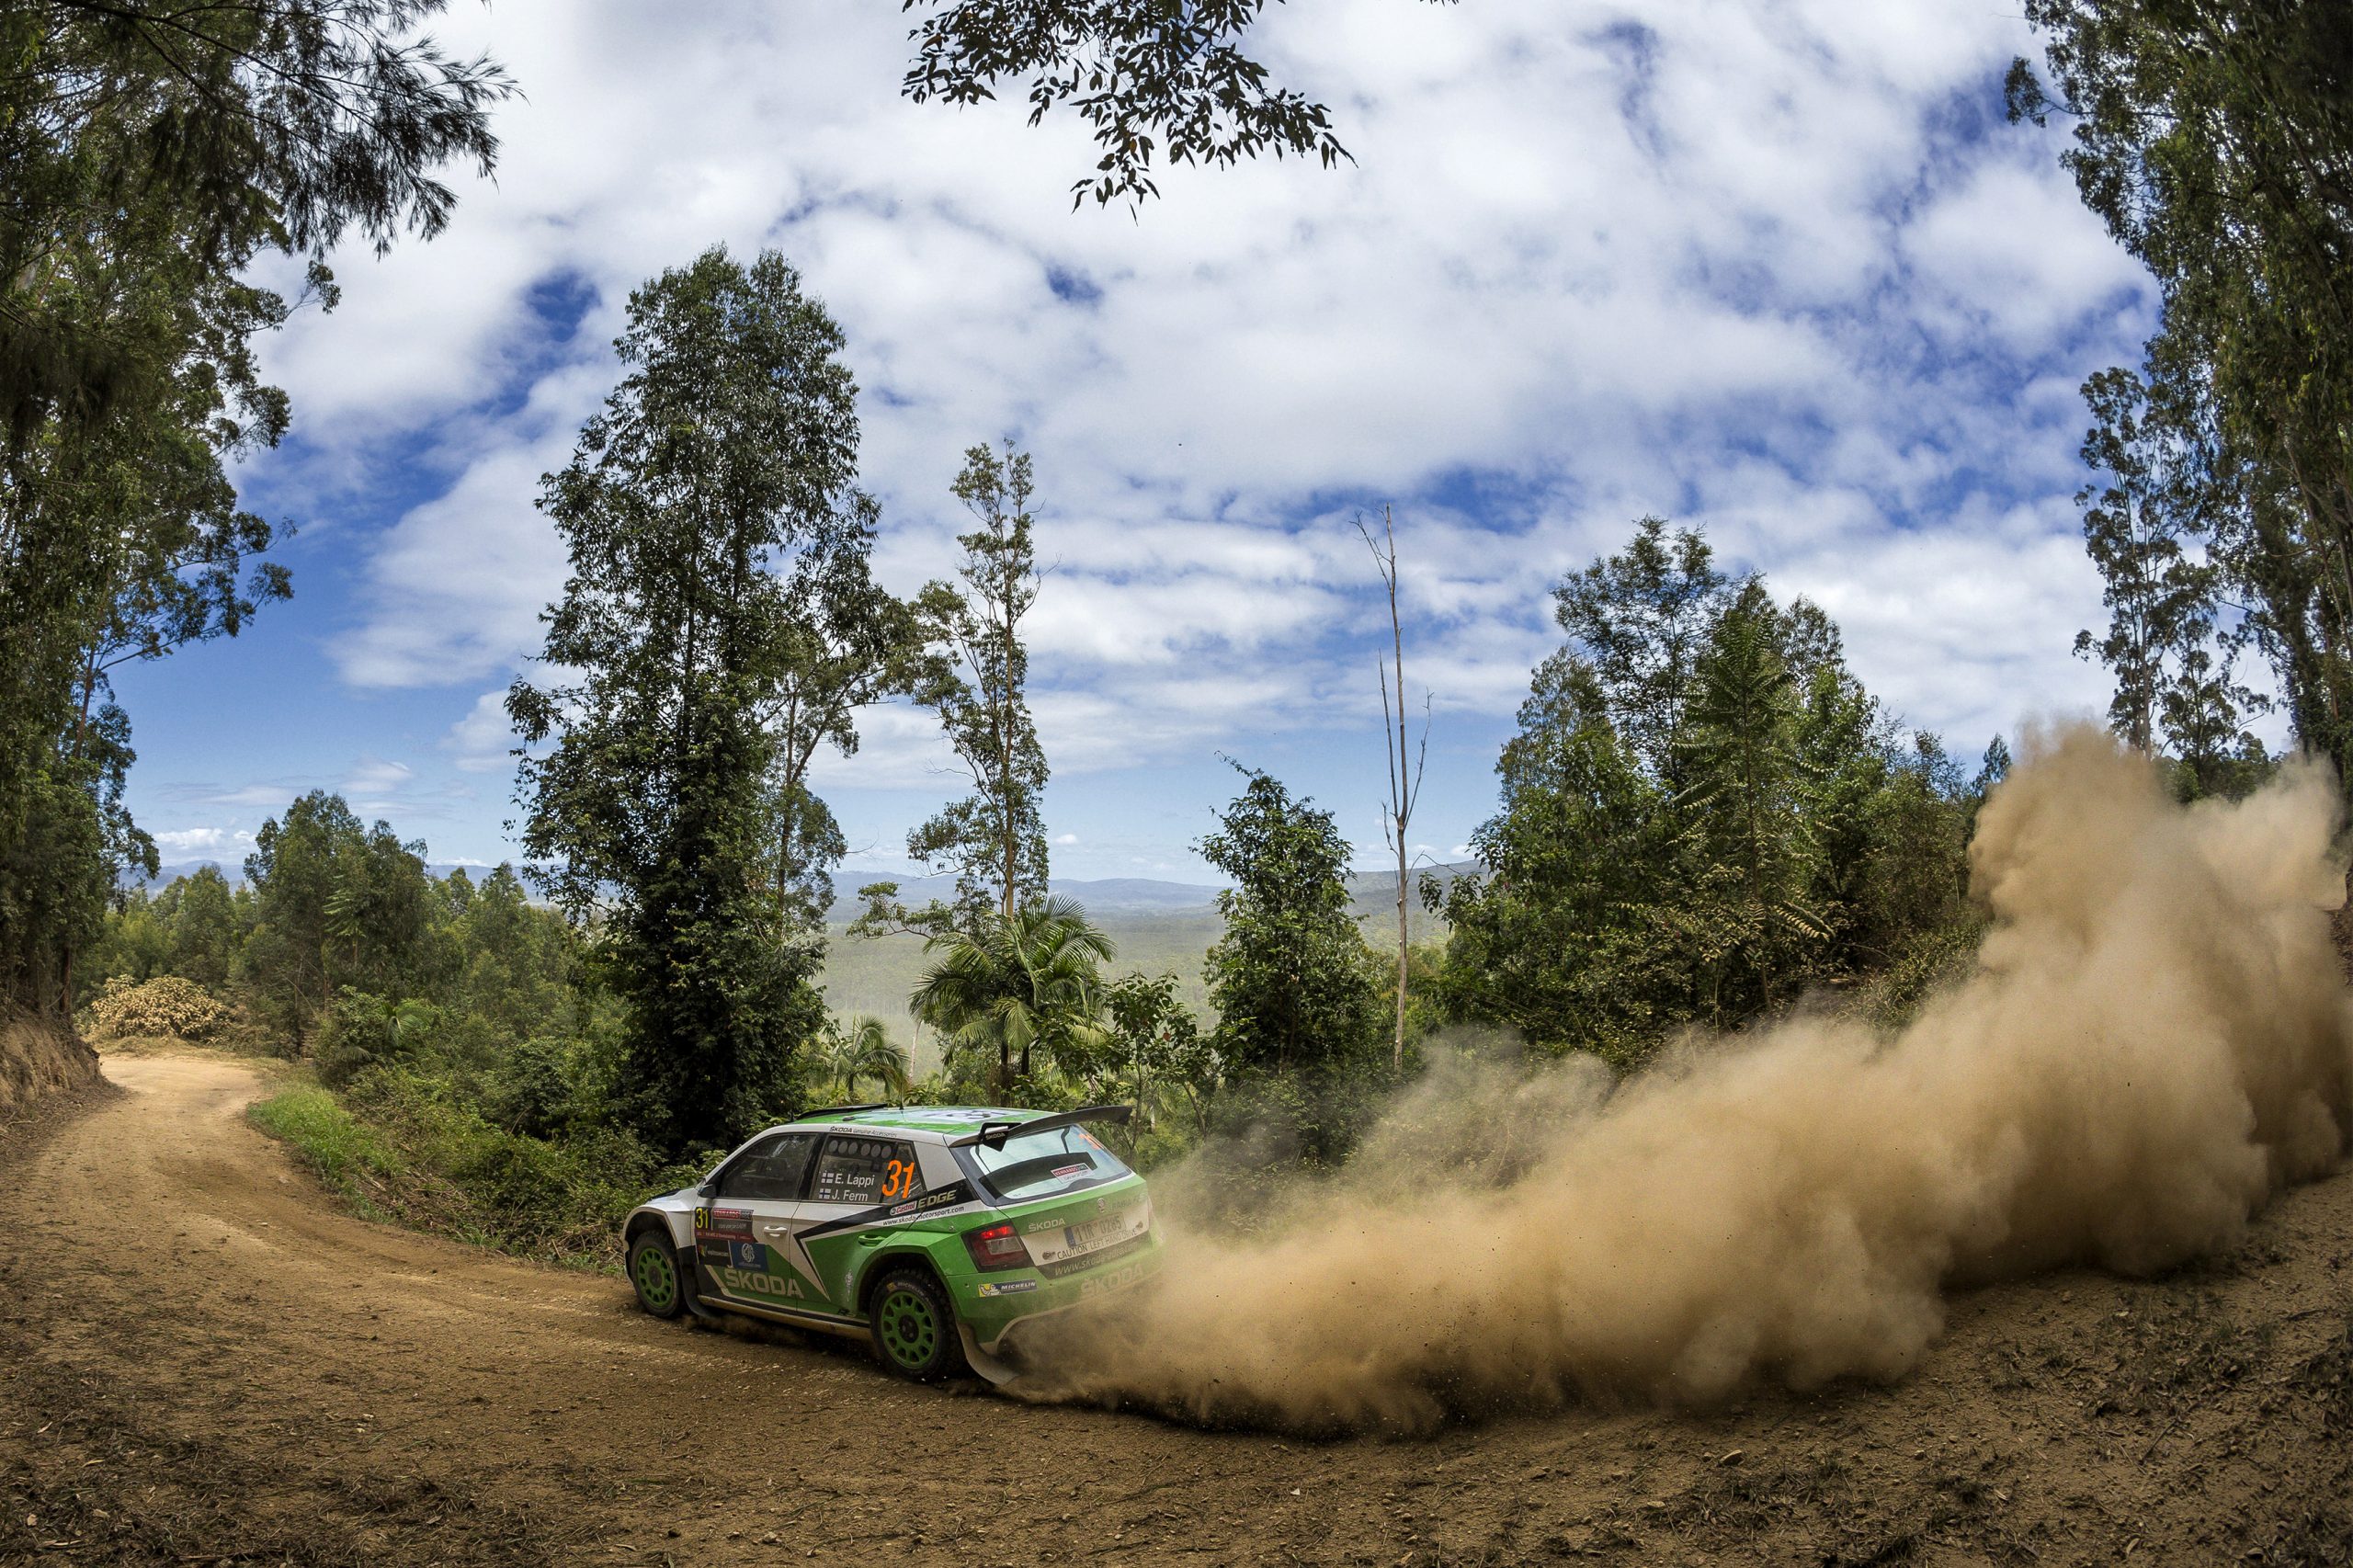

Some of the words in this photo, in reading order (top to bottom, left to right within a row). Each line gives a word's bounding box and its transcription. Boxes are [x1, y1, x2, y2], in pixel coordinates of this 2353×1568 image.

[835, 1173, 844, 1184] E.
[847, 1174, 875, 1188] Lappi
[881, 1159, 915, 1199] 31
[831, 1191, 840, 1200] J.
[843, 1191, 868, 1201] Ferm
[895, 1201, 915, 1214] Castrol
[917, 1189, 957, 1210] EDGE
[696, 1208, 709, 1229] 31
[1029, 1217, 1066, 1233] ŠKODA
[1057, 1244, 1088, 1259] CAUTION
[1090, 1239, 1102, 1249] LEFT
[1103, 1233, 1120, 1244] HAND
[724, 1265, 804, 1300] ŠKODA
[1001, 1281, 1036, 1290] MICHELIN
